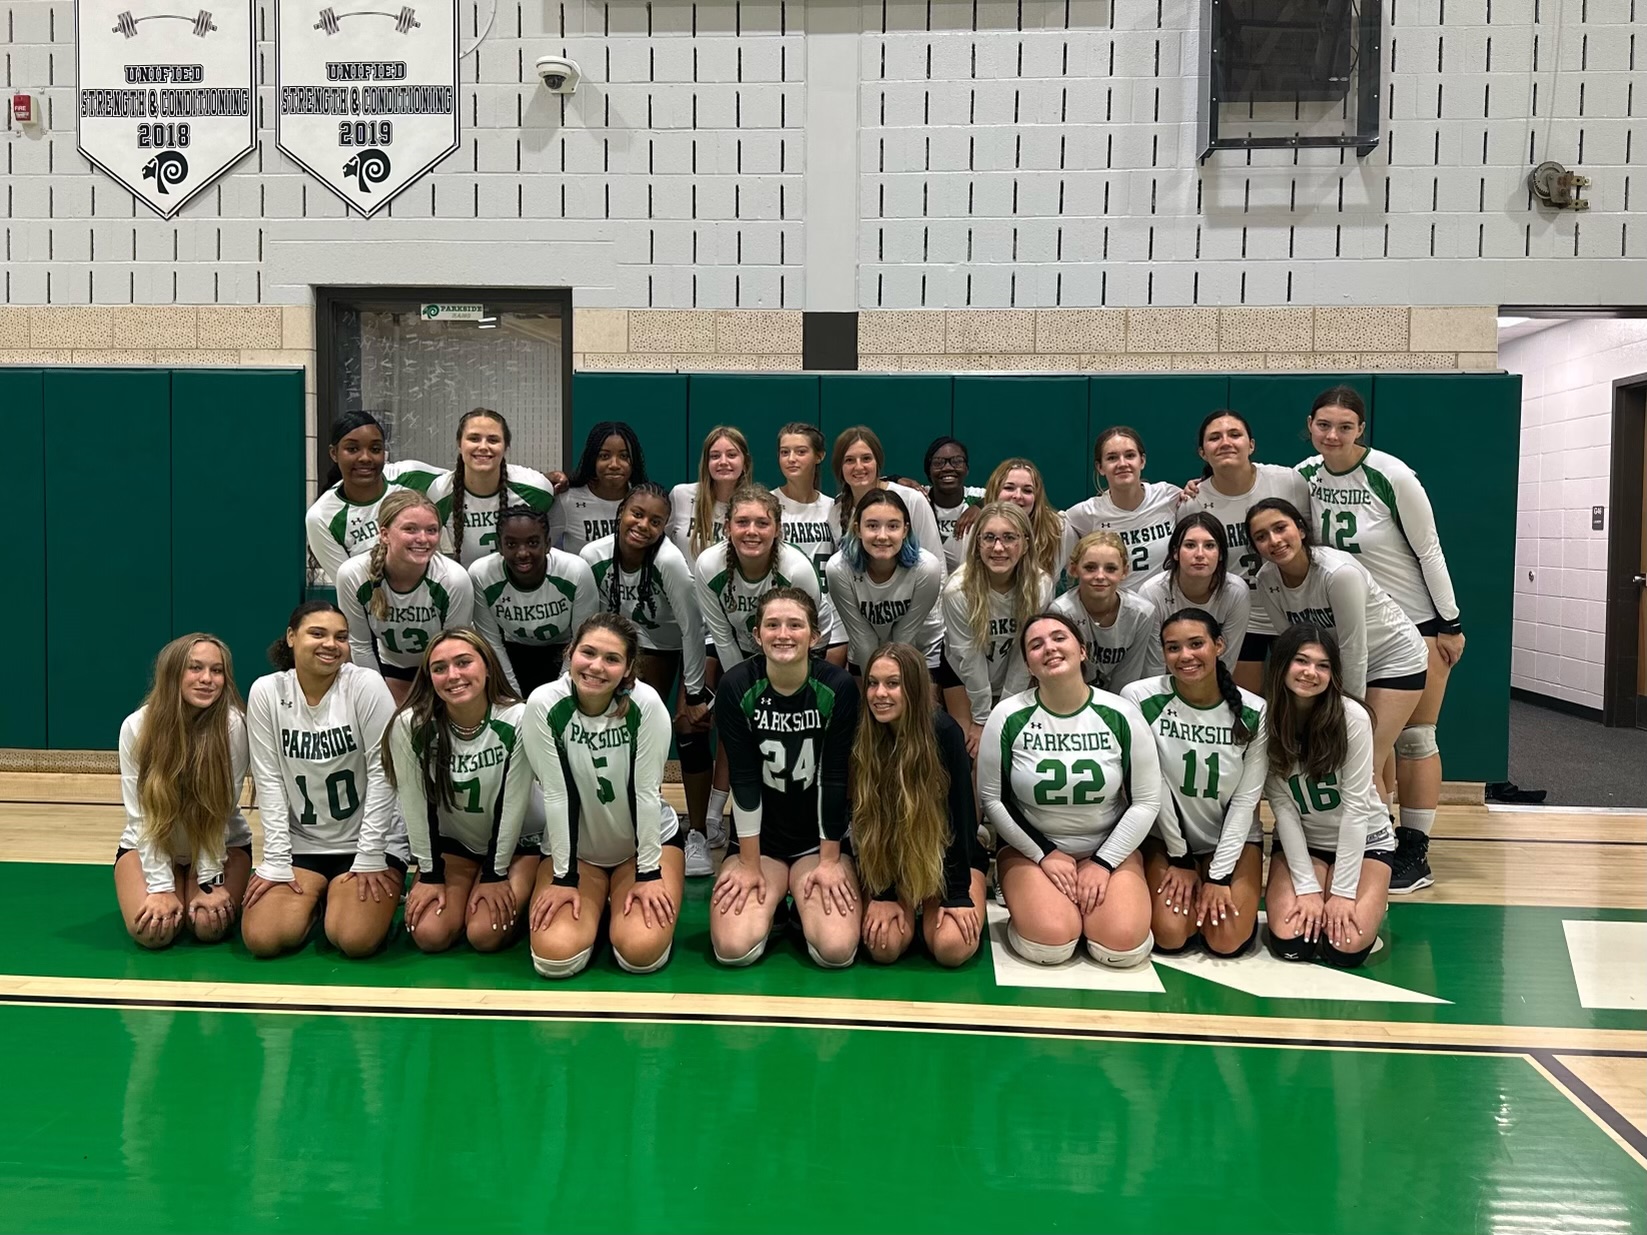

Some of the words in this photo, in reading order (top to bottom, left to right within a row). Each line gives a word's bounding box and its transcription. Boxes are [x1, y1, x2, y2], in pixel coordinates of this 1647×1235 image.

[124, 64, 204, 84] UNIFIED
[326, 61, 407, 81] UNIFIED
[81, 89, 147, 117] STRENGTH
[148, 89, 159, 119] &
[160, 88, 249, 117] CONDITIONING
[281, 86, 349, 115] STRENGTH
[350, 86, 361, 117] &
[362, 85, 453, 115] CONDITIONING
[137, 123, 190, 149] 2018
[338, 120, 393, 146] 2019
[1310, 483, 1371, 505] PARKSIDE
[783, 522, 831, 543] PARKSID
[1119, 521, 1172, 545] RKSIDE
[1321, 508, 1362, 554] 12
[1131, 546, 1149, 571] 2
[495, 597, 569, 622] PARKSIDE
[381, 627, 430, 654] 13
[281, 724, 358, 760] PARKSIDE
[1022, 731, 1112, 752] PARKSIDE
[1159, 718, 1234, 746] PARKSID
[449, 745, 504, 773] RKSIDE
[759, 738, 817, 793] 24
[1033, 758, 1106, 806] 22
[1179, 749, 1220, 800] 11
[294, 768, 360, 825] 10
[452, 776, 485, 813] 7
[1287, 771, 1342, 815] 16
